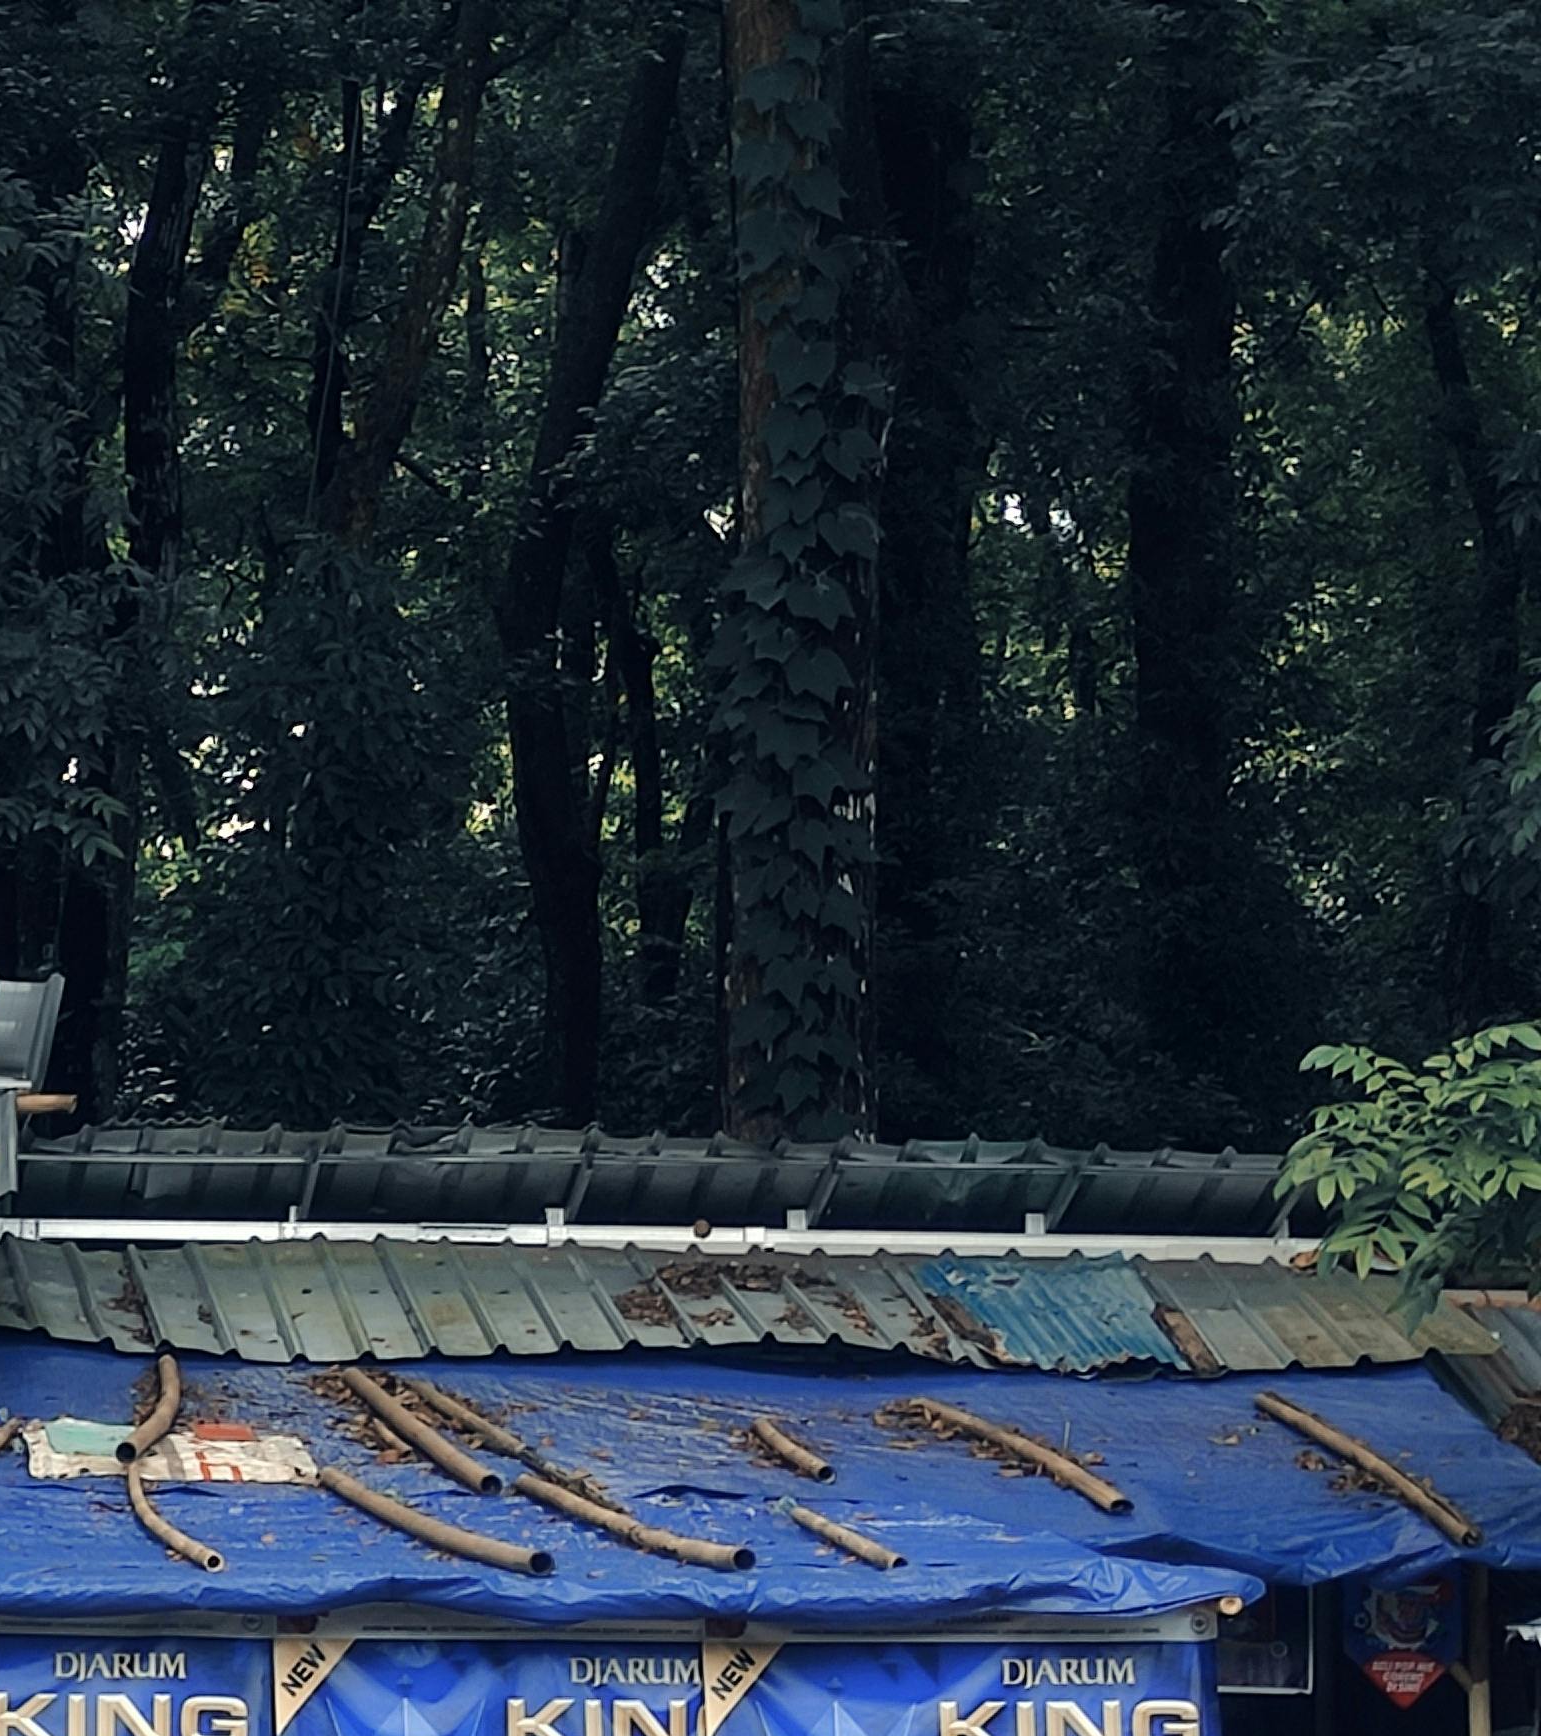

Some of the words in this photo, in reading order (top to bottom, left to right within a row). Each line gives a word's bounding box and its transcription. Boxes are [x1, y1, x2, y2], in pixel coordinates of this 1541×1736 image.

[54, 1652, 187, 1682] DJARUM
[281, 1643, 327, 1698] NEW
[569, 1657, 701, 1688] DJARUM
[712, 1648, 755, 1700] NEW
[1001, 1657, 1135, 1688] DJARUM
